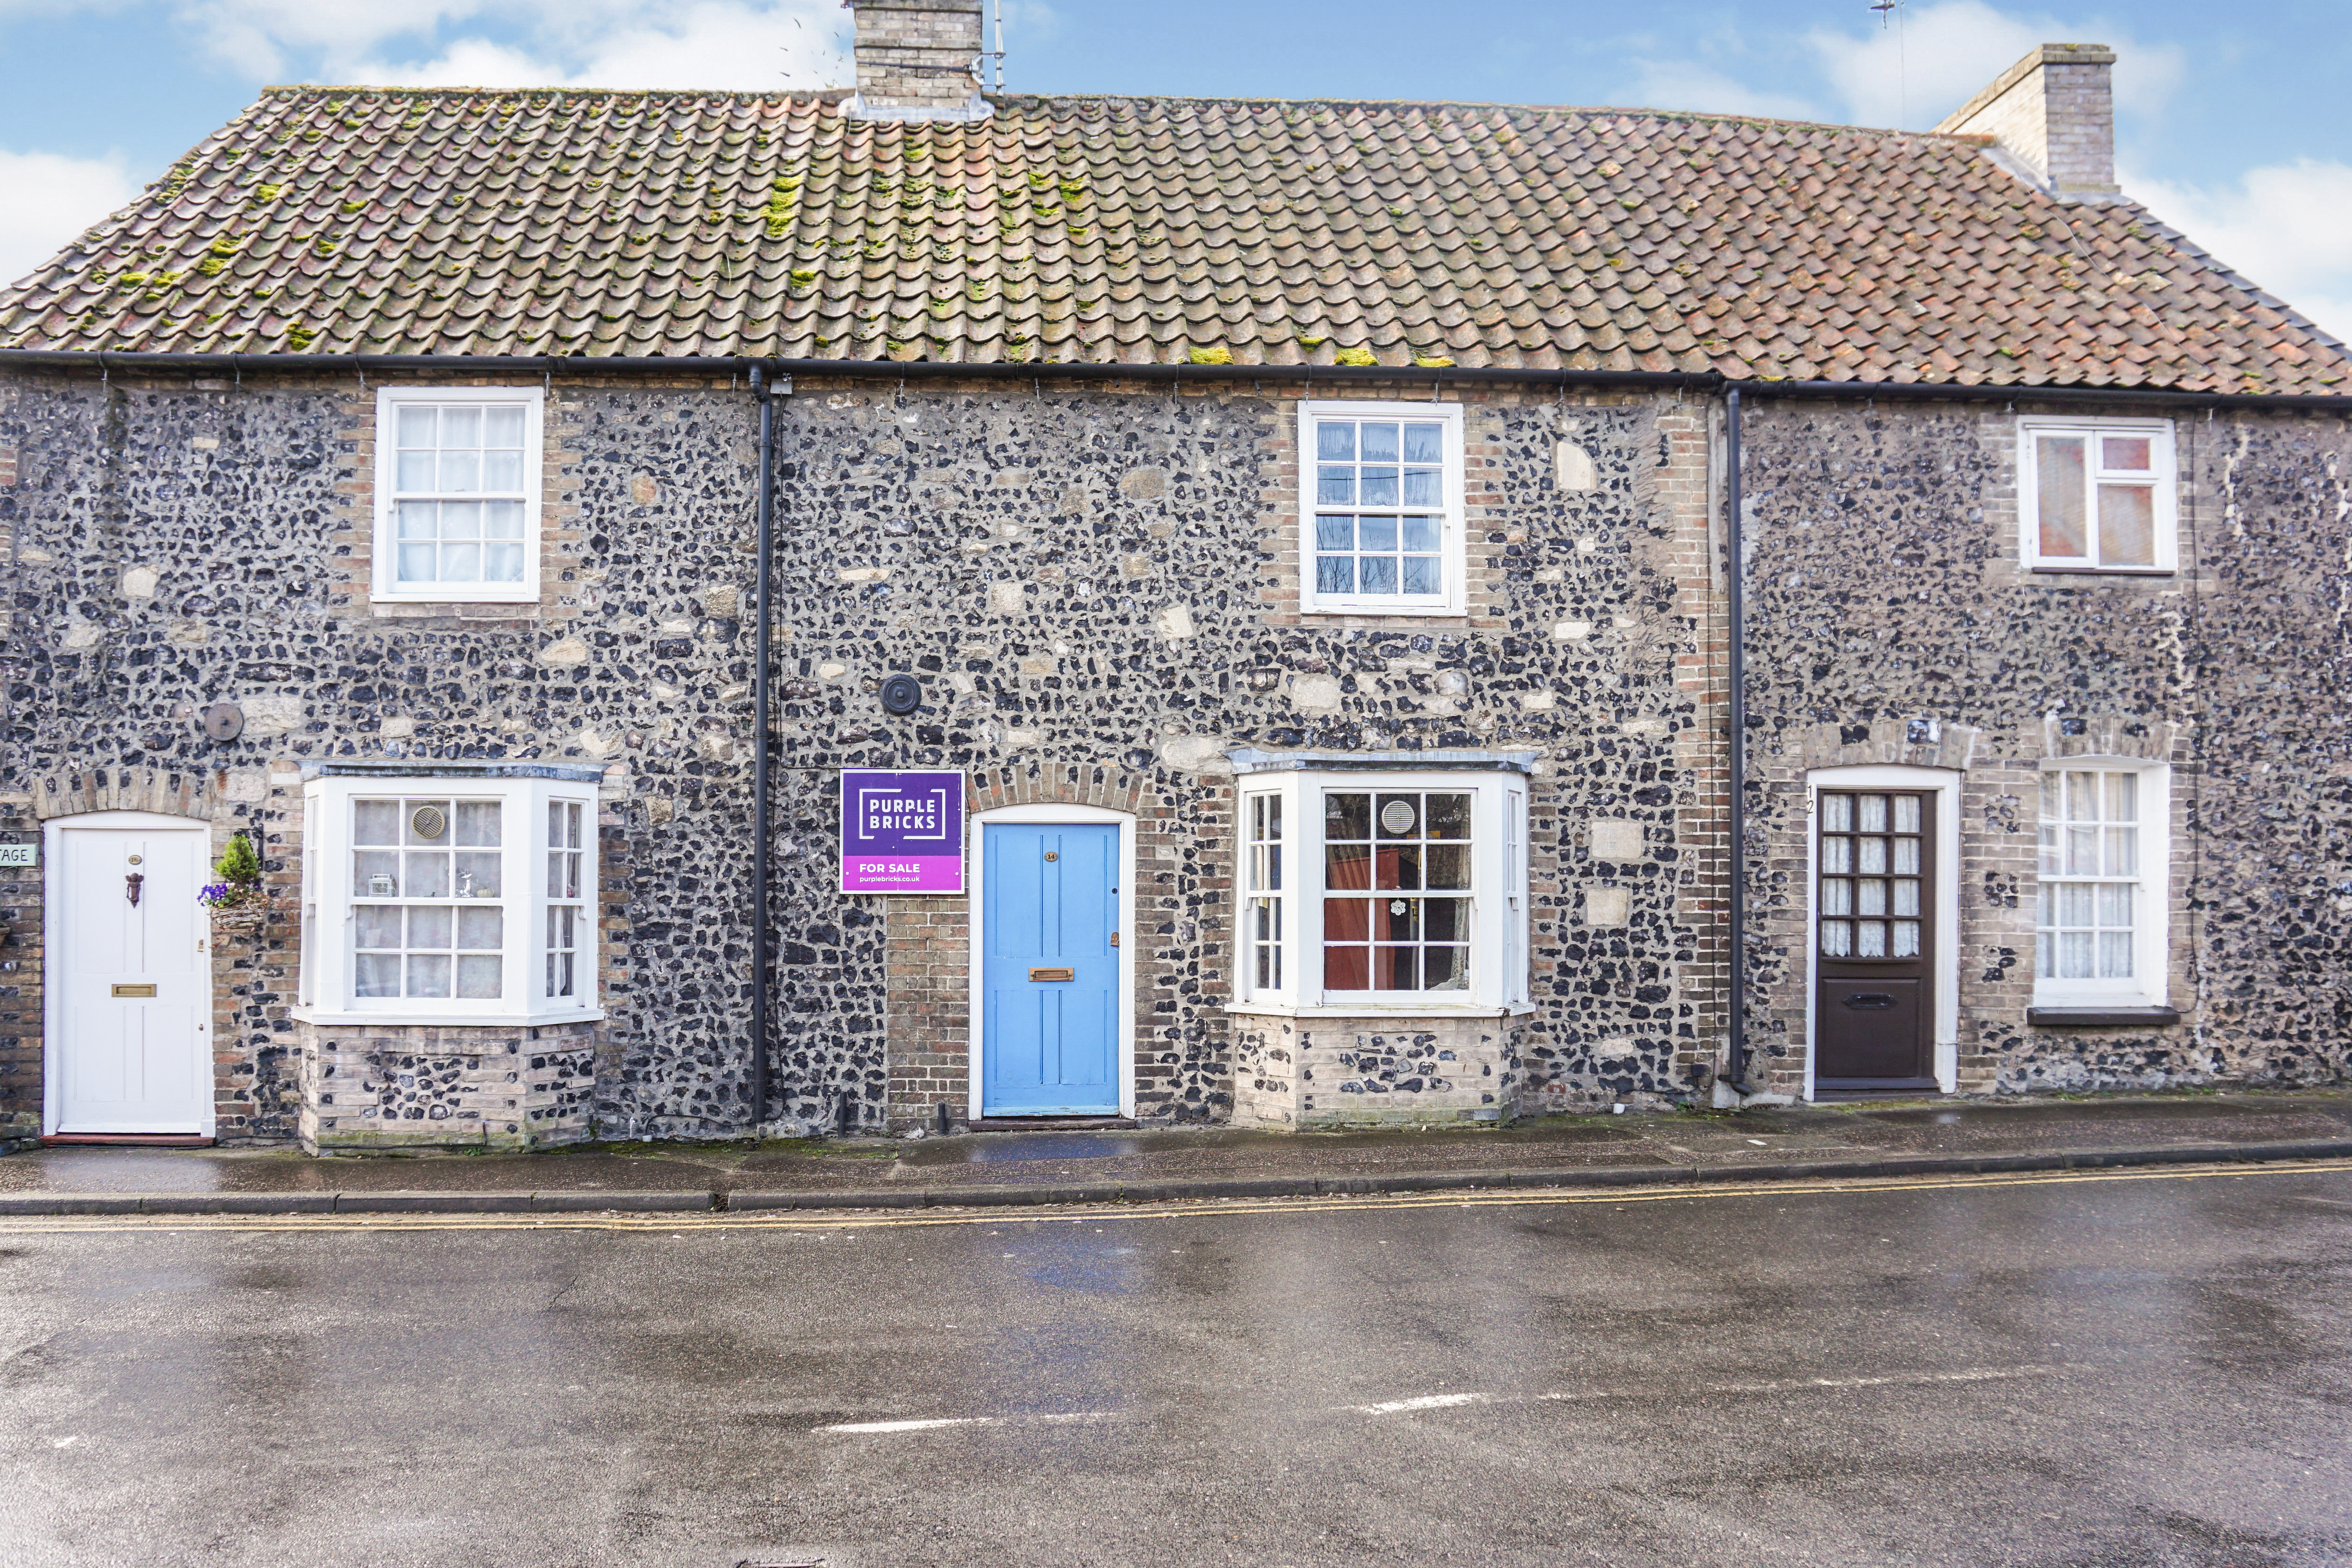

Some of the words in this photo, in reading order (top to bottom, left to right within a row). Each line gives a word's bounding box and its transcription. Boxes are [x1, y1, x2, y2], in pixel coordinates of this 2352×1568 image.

[1807, 784, 1814, 813] 12
[869, 799, 935, 813] PURPLE
[869, 815, 935, 829] BRICKS
[860, 864, 885, 873] FOR
[889, 864, 920, 873] SALE
